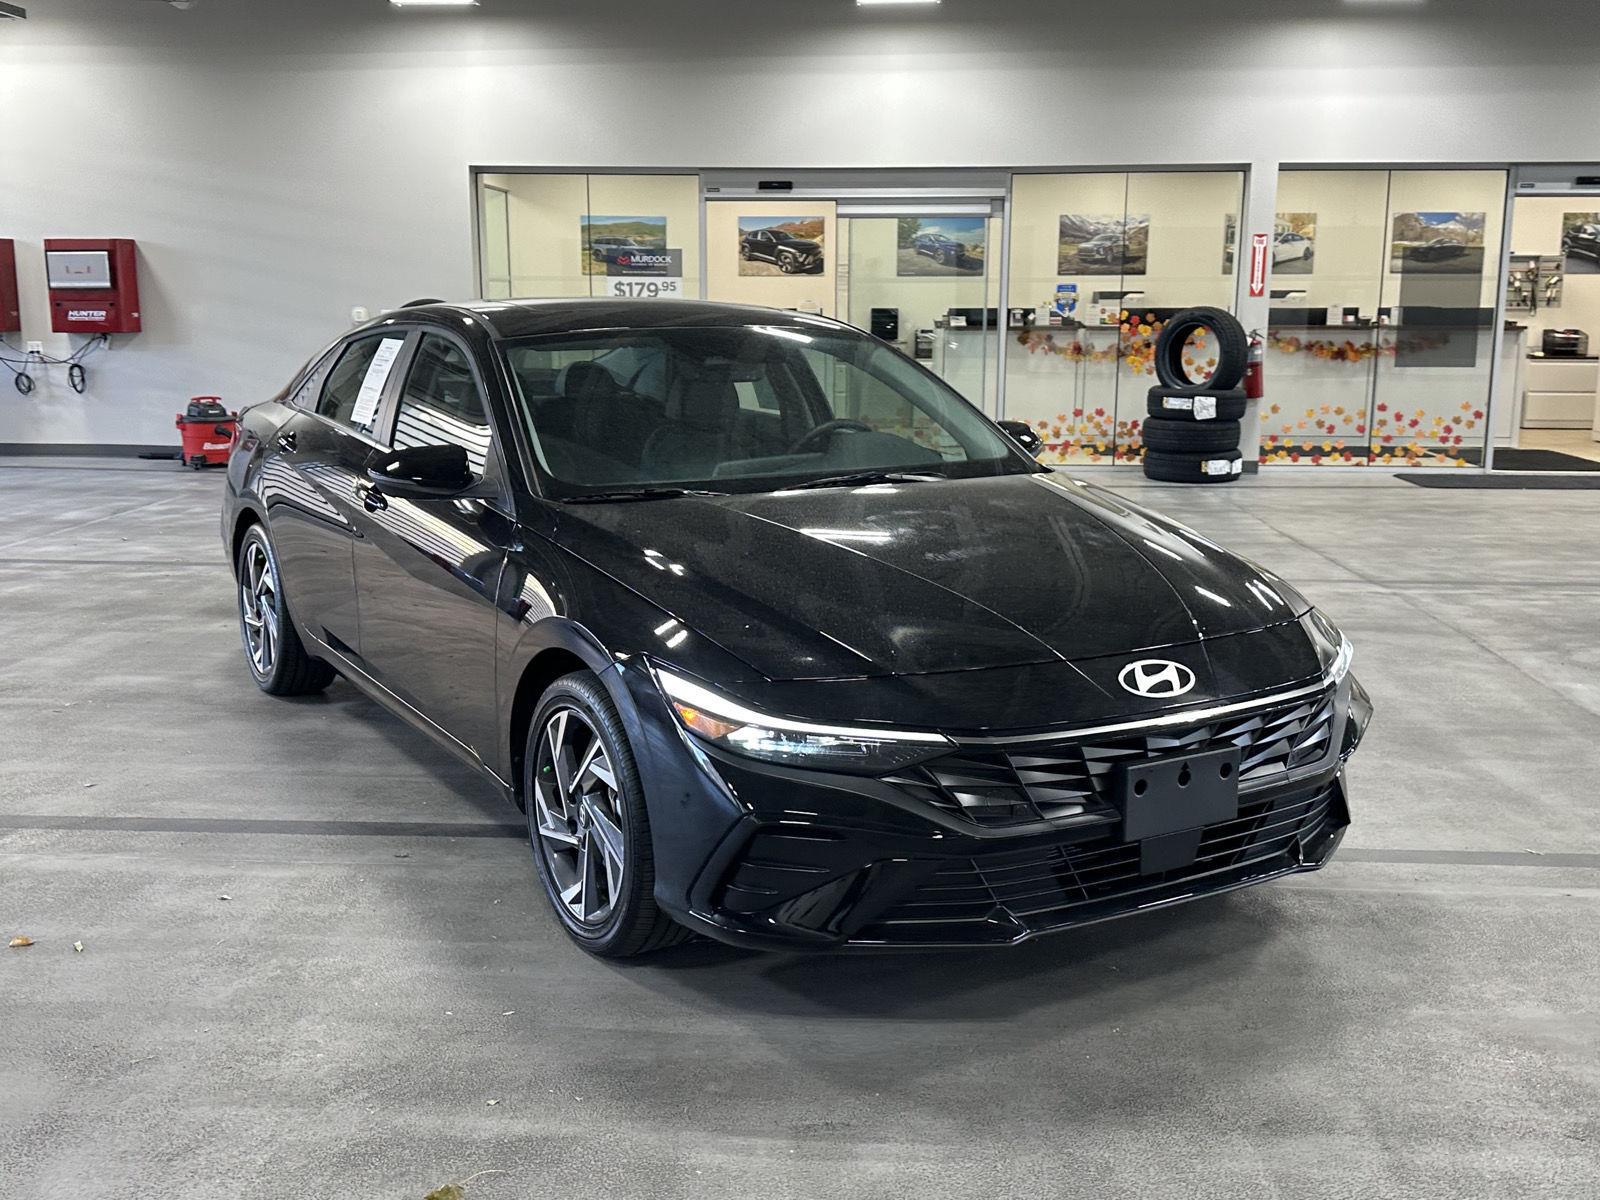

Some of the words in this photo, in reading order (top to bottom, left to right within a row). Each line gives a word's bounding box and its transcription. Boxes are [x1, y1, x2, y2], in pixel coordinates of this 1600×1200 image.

[630, 255, 672, 263] MURDOCK
[614, 280, 677, 297] $179.95
[68, 310, 107, 318] HUNTER
